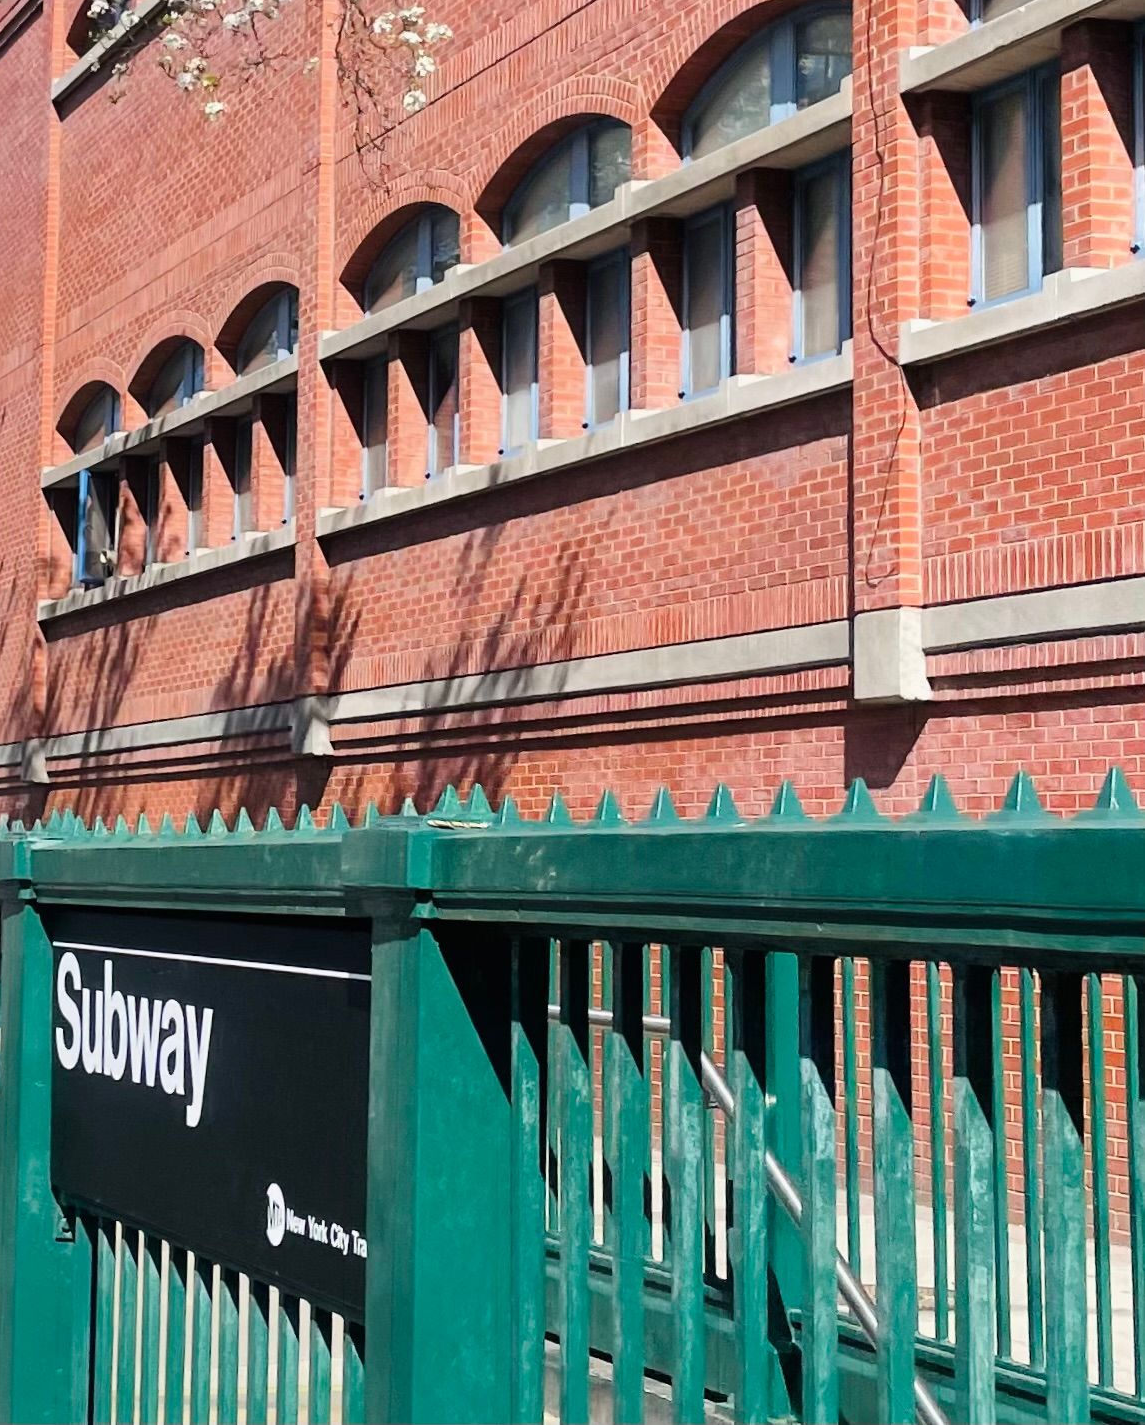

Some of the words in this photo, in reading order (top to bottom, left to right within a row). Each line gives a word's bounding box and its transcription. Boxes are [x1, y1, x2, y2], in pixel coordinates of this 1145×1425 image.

[56, 951, 214, 1128] Subway
[286, 1207, 306, 1235] New
[308, 1215, 329, 1244] York
[330, 1223, 350, 1255] City
